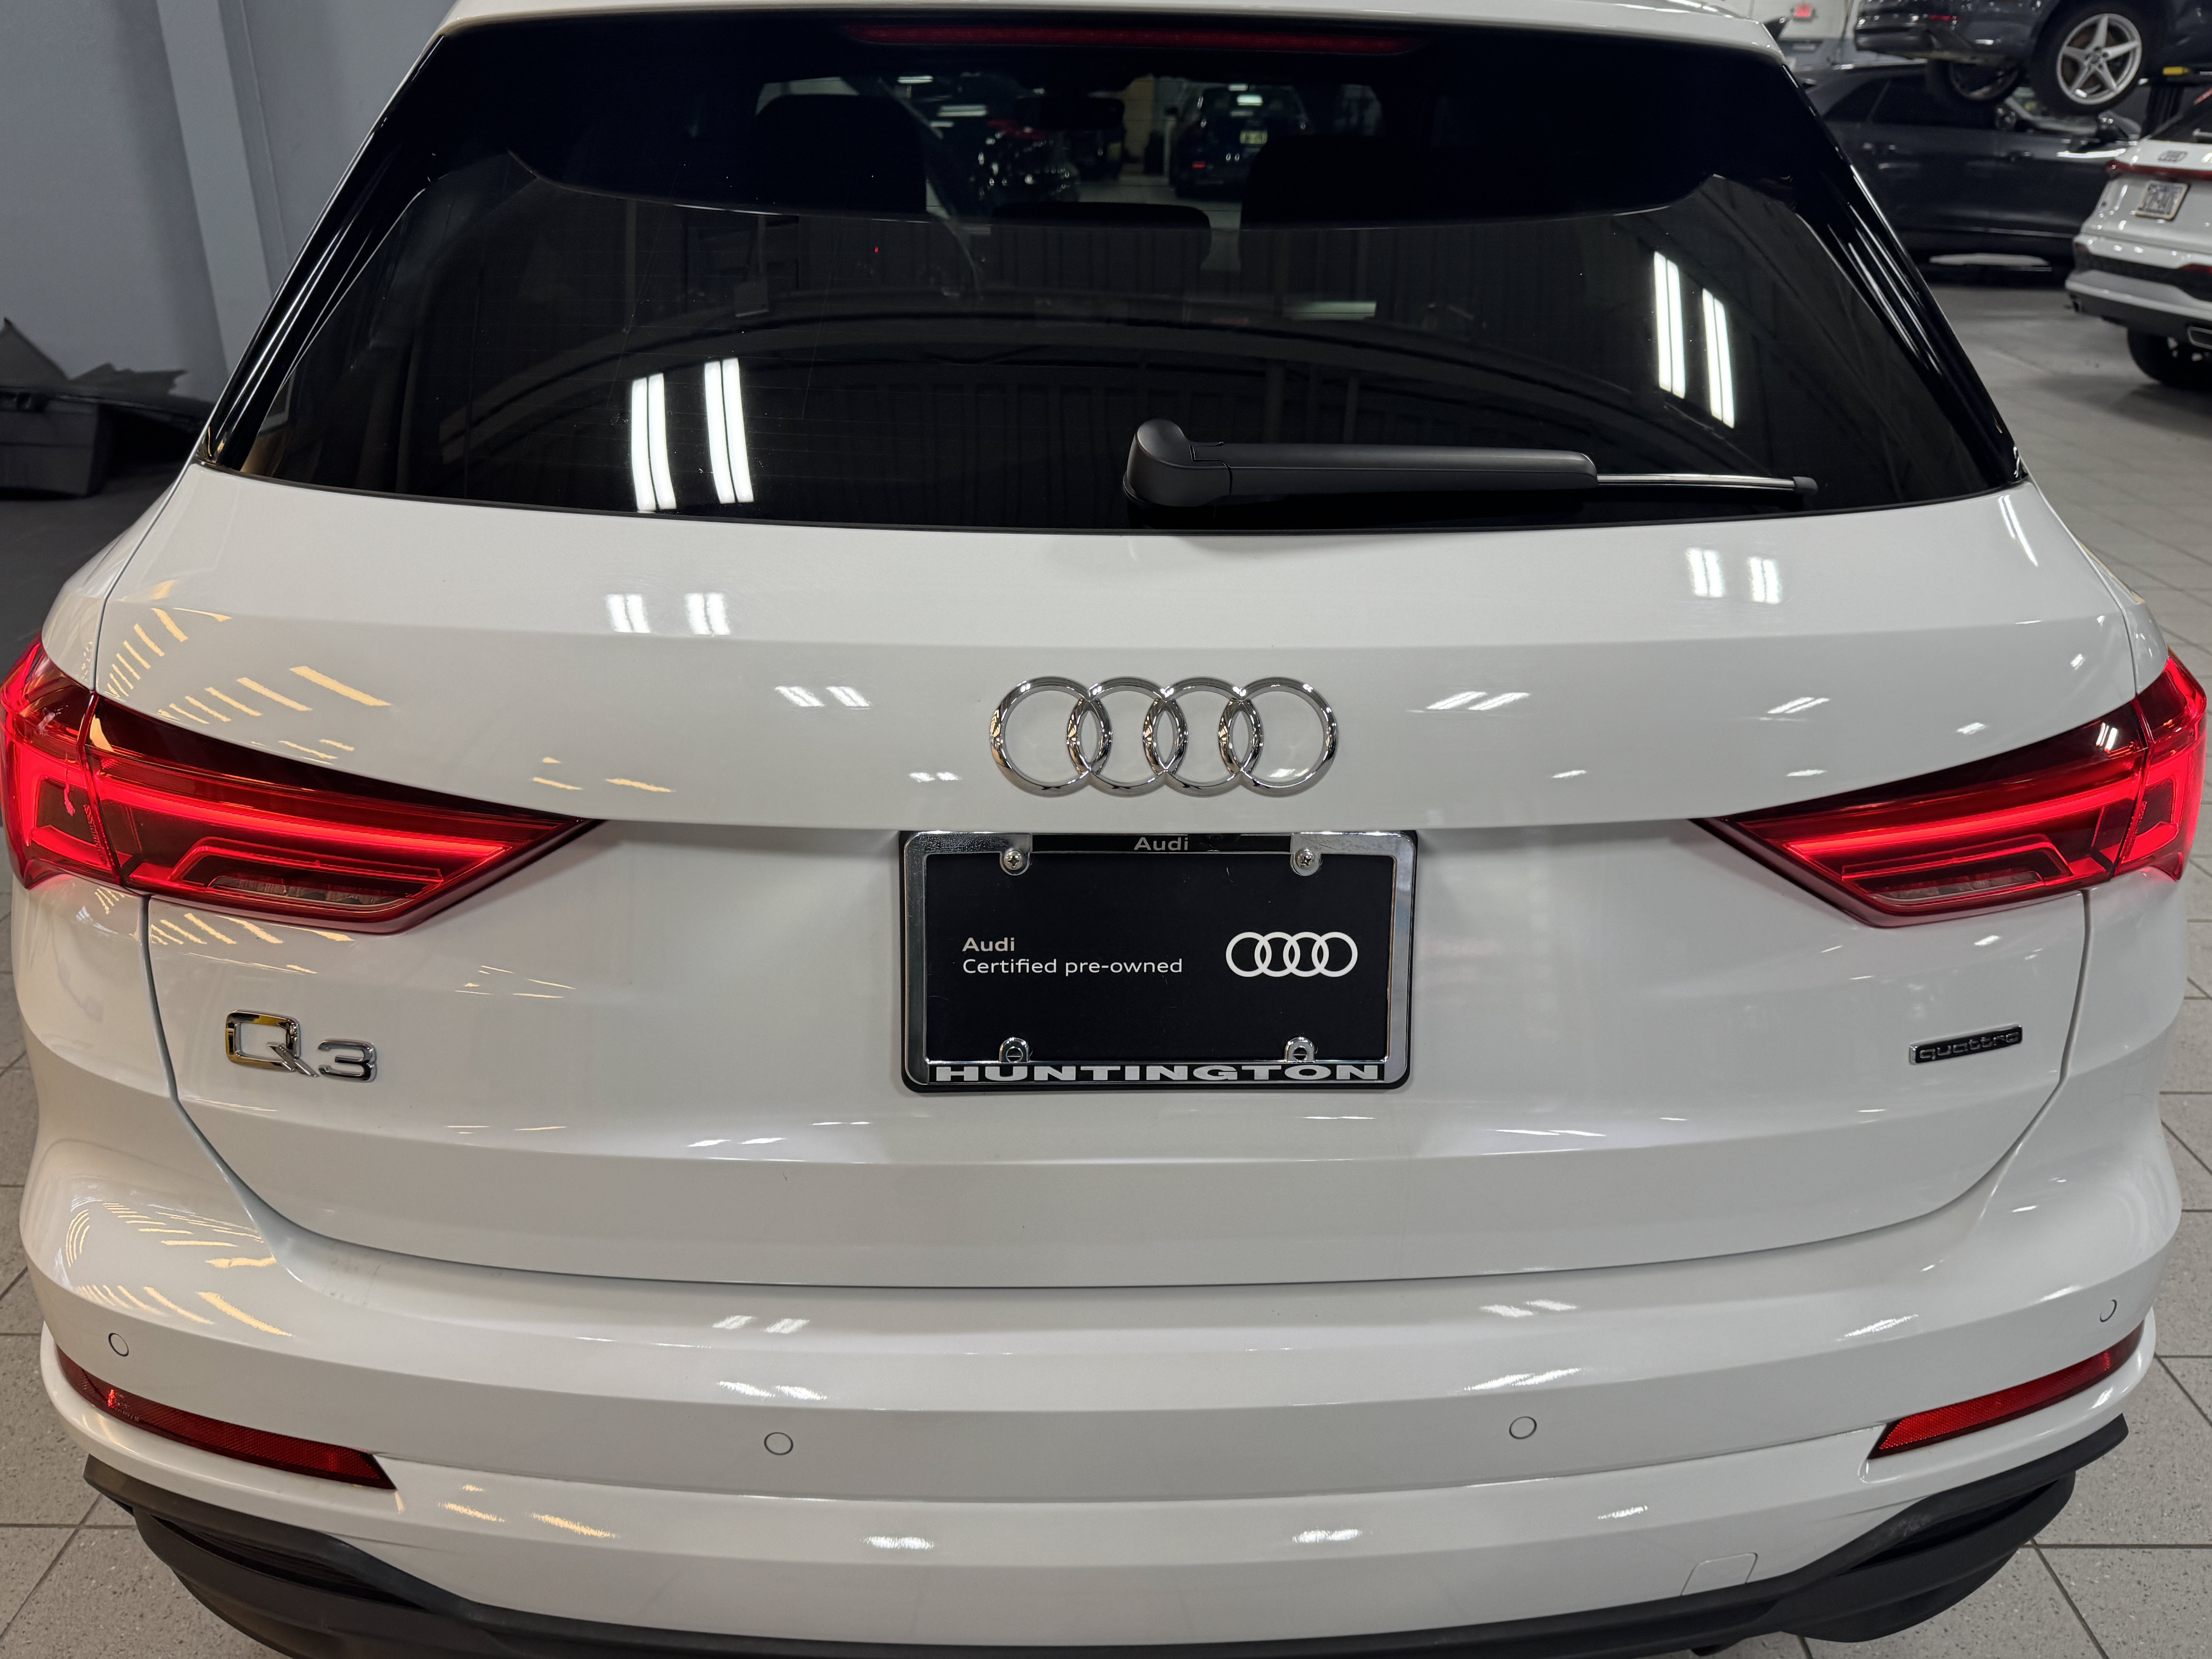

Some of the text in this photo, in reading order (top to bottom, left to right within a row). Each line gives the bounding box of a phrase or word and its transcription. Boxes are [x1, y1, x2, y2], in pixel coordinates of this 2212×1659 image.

[1134, 837, 1188, 851] Audi
[962, 937, 1015, 952] Audi
[963, 958, 1182, 977] Certified pre-owned
[225, 1009, 377, 1083] Q3
[1918, 1032, 2020, 1060] quattro
[936, 1065, 1378, 1082] HUNTINGTON
